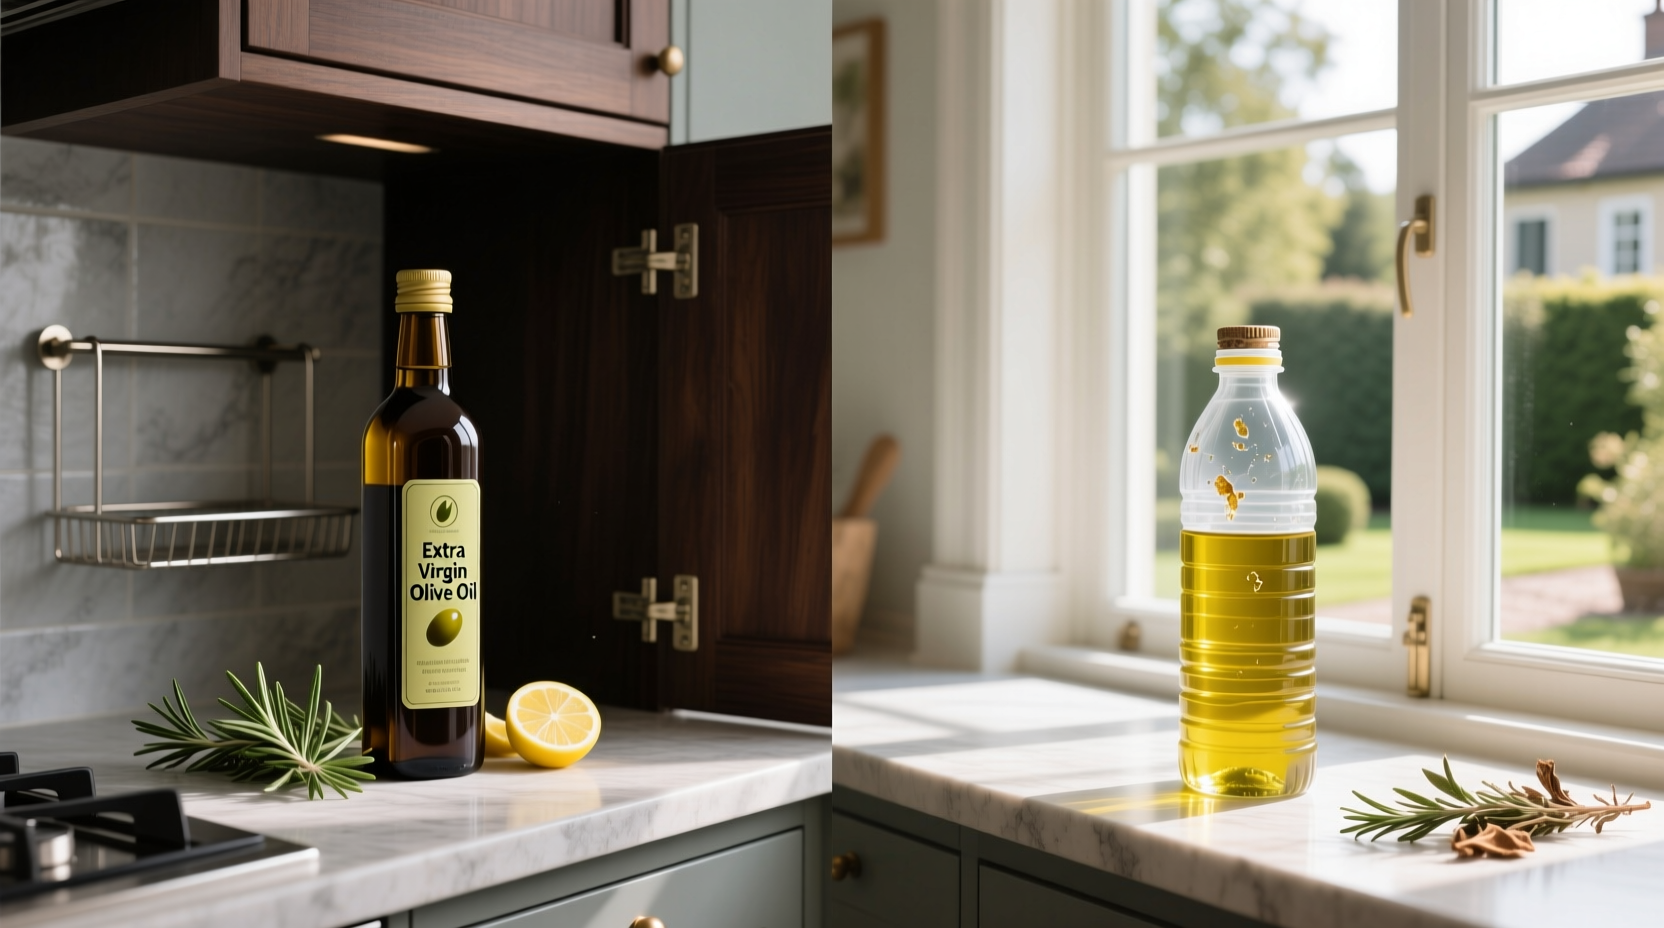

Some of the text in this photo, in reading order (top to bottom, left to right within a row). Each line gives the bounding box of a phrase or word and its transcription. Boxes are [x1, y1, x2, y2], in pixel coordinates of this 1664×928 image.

[422, 542, 466, 559] Extra
[417, 561, 468, 584] Virgin
[409, 581, 477, 601] Olive Oil
